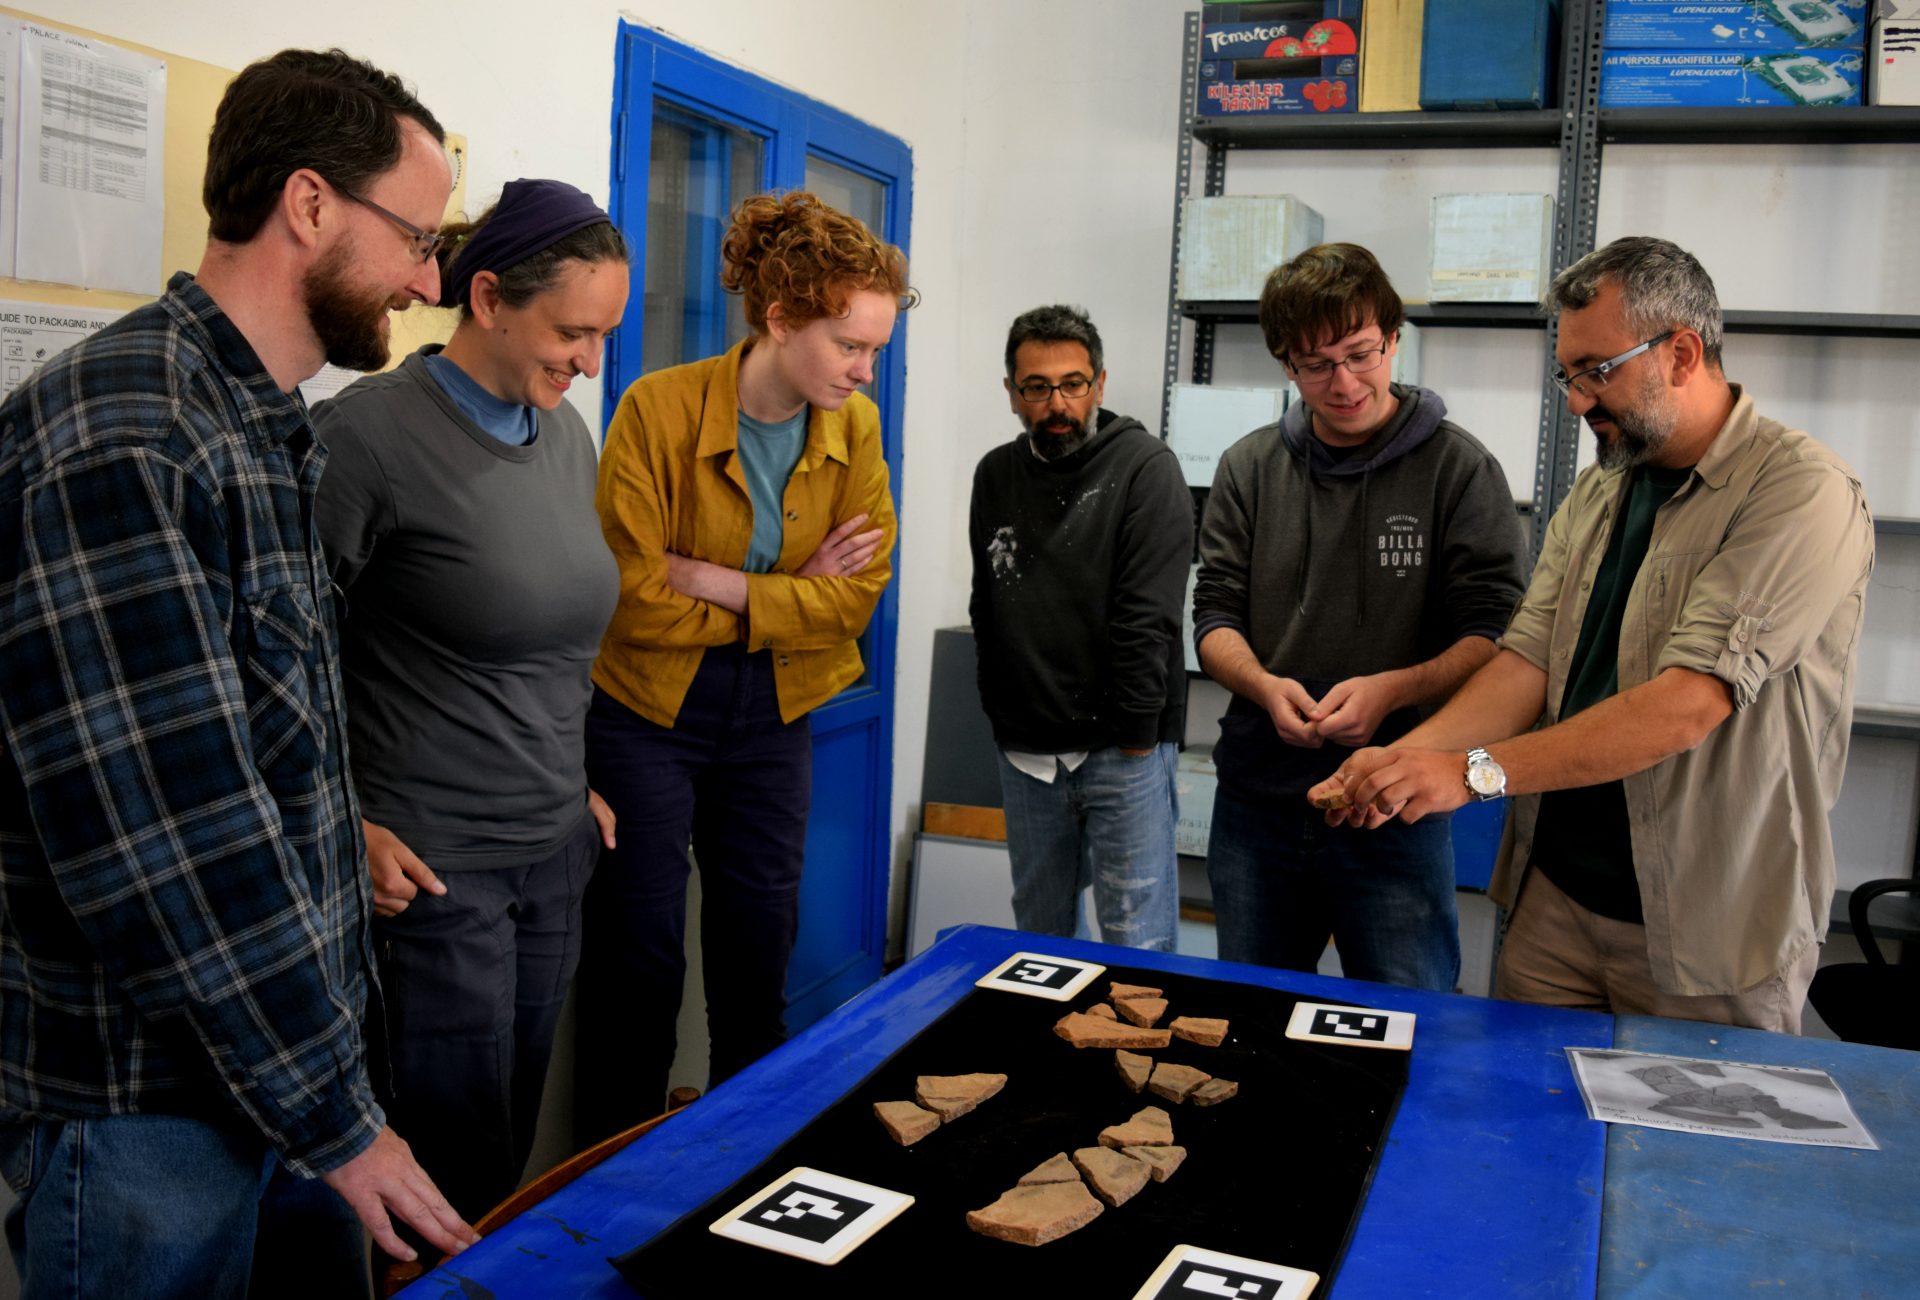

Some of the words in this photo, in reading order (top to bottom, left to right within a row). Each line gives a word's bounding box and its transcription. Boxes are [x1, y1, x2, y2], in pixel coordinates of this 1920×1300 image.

[30, 26, 60, 40] PALACE
[1619, 56, 1661, 65] PURPOSE
[1662, 56, 1714, 65] MAGNIFIER
[1715, 55, 1741, 64] LAMP
[1220, 96, 1270, 112] TARIM
[25, 315, 36, 324] TO
[40, 316, 87, 328] PACKAGING
[1378, 534, 1423, 549] BILLA
[1380, 551, 1422, 566] BONG
